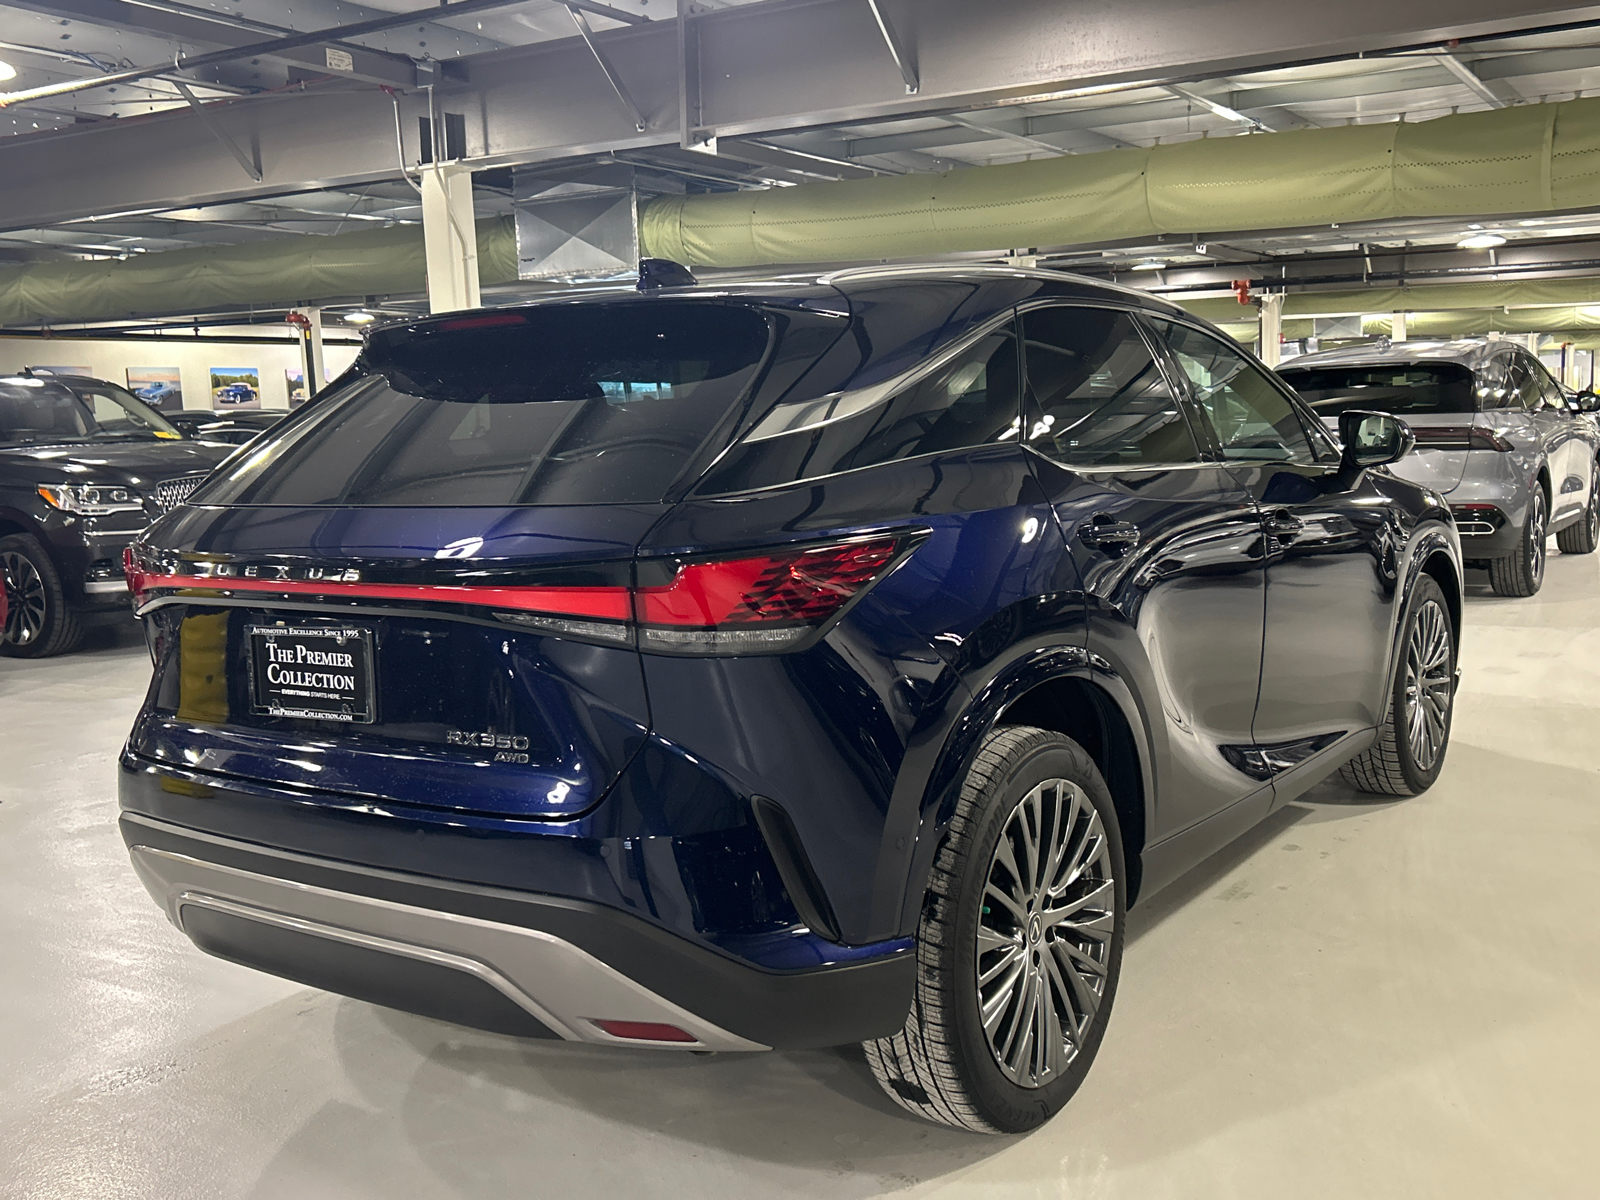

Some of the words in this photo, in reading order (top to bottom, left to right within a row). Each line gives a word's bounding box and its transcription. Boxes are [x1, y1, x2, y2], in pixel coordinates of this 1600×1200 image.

[216, 563, 361, 582] LEXUS
[343, 629, 359, 638] 1995
[265, 642, 294, 663] THE
[295, 644, 354, 668] PREMIER
[267, 663, 355, 690] COLLECTION
[281, 688, 311, 697] EVERYTHING
[311, 691, 328, 699] STARTS
[493, 751, 530, 764] AWD
